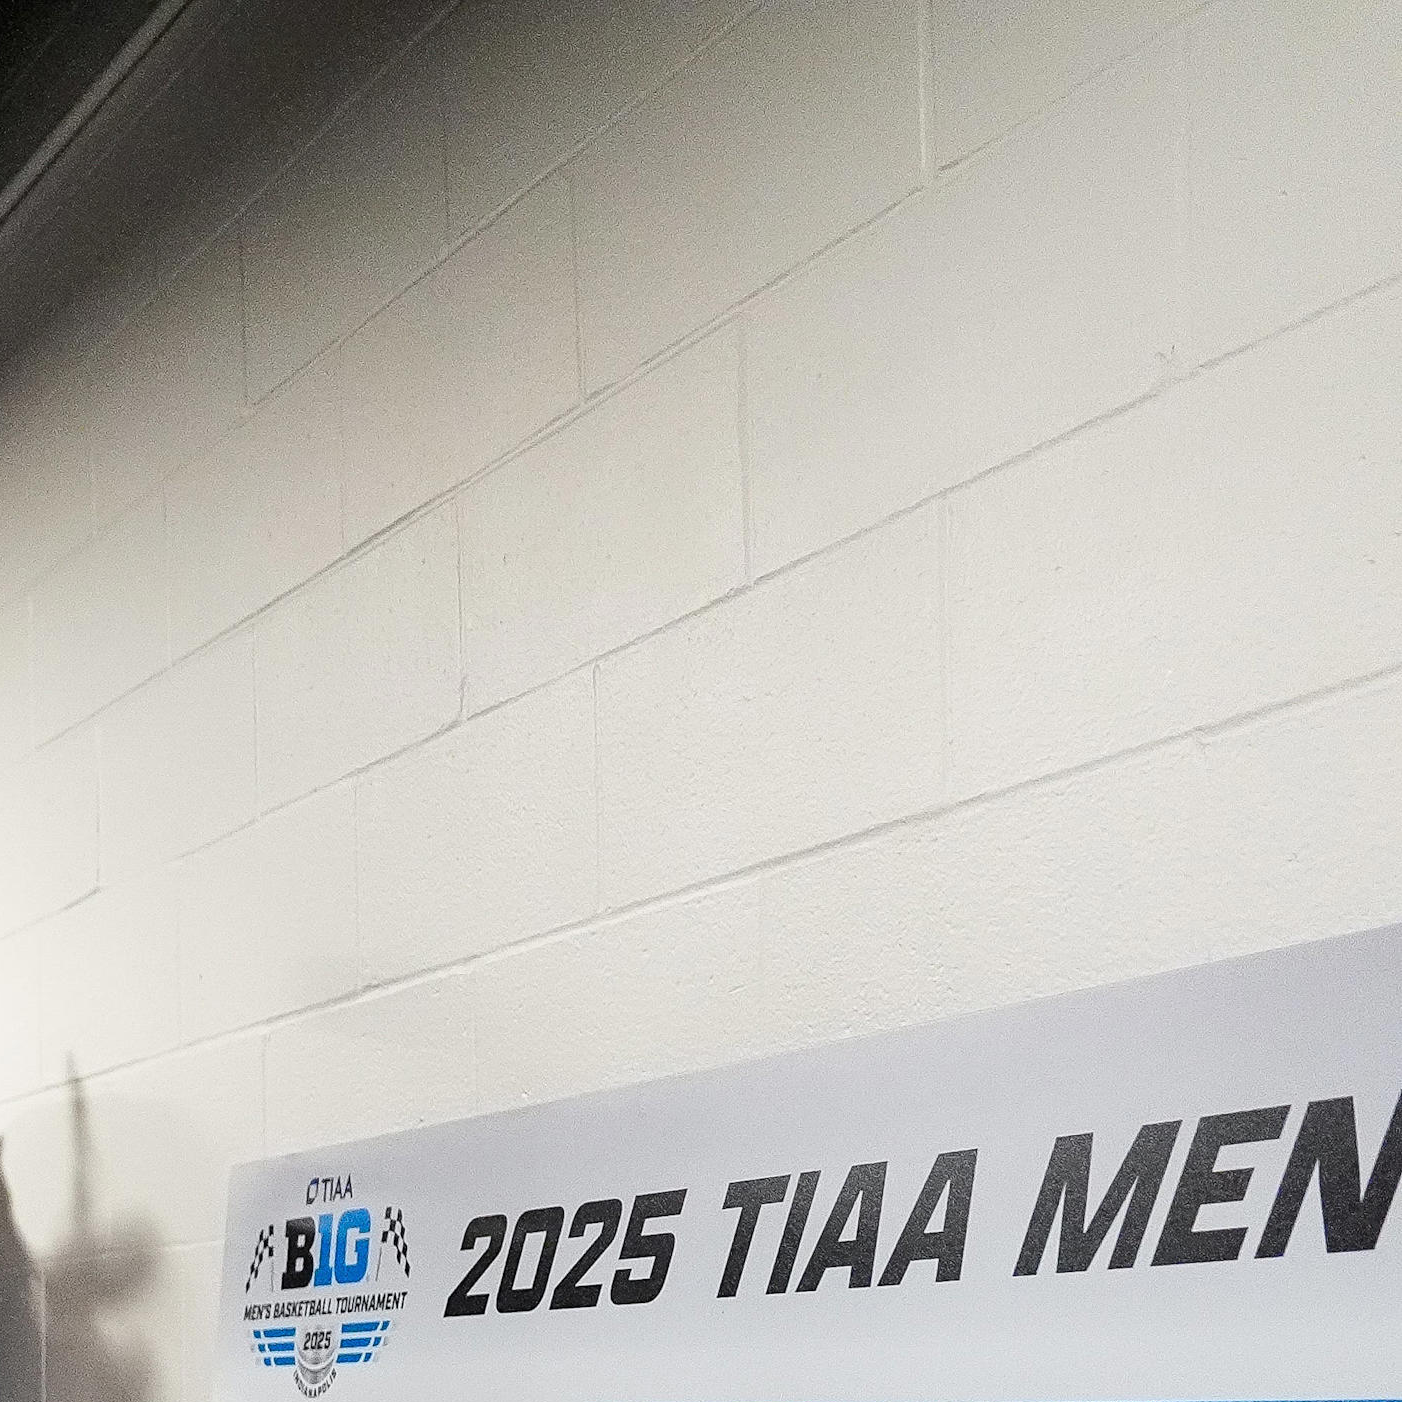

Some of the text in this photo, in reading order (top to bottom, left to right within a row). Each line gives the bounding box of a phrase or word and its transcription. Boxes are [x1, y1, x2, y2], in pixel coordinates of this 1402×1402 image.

[321, 1173, 353, 1203] TIAA
[443, 1092, 1402, 1318] 2025 TIAA MEN
[243, 1291, 408, 1321] MEN'S BASKETBALL TOURNAMENT
[303, 1330, 332, 1351] 2025
[292, 1367, 338, 1399] INDIANAPOLIS
